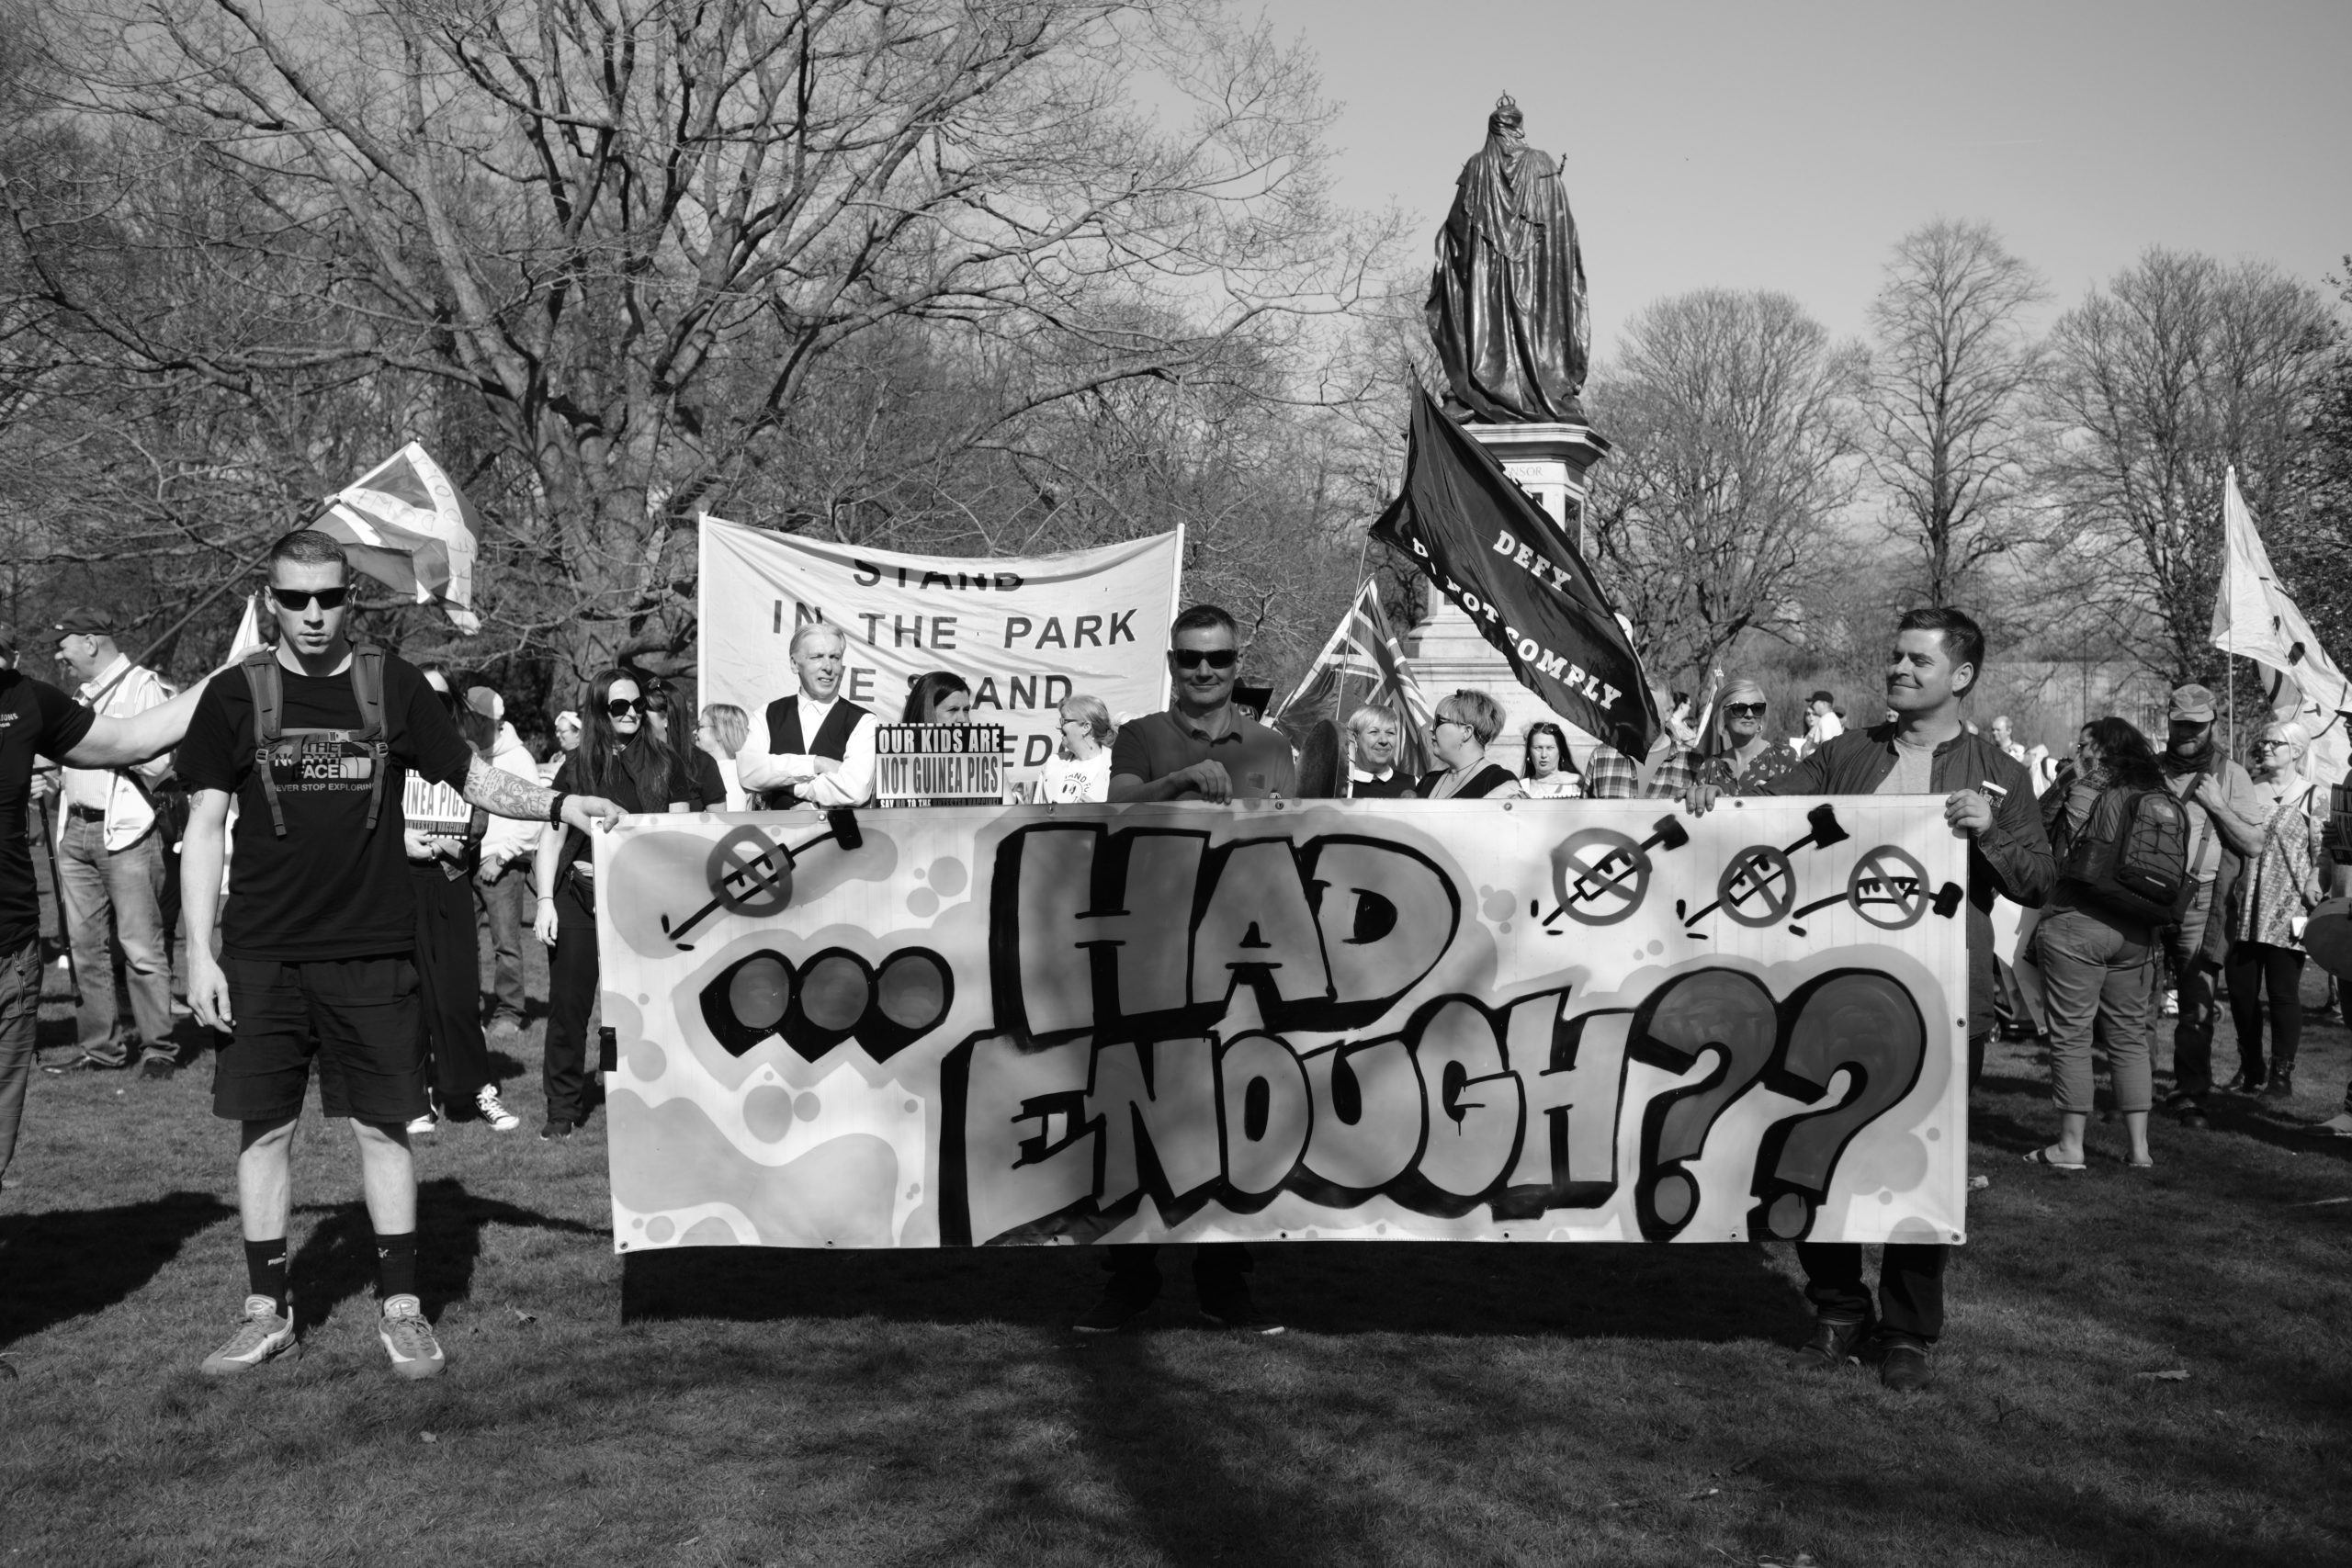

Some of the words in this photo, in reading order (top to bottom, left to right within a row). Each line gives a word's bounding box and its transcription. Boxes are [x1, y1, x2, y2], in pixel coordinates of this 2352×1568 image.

[1510, 466, 1544, 477] NSOR
[1493, 530, 1572, 592] DEFY
[858, 612, 957, 649] THE
[1004, 608, 1137, 649] PARK
[838, 665, 876, 703] E
[0, 713, 18, 721] IONS
[878, 729, 915, 753] OUR
[921, 728, 963, 752] KIDS
[968, 728, 1000, 752] ARE
[300, 764, 339, 778] ACE
[881, 757, 908, 795] NOT
[913, 756, 963, 795] GUINEA
[967, 756, 999, 794] PIGS
[276, 784, 299, 792] EVER
[301, 784, 326, 792] STOP
[328, 783, 373, 792] EXPLORIN
[405, 781, 435, 816] INEA
[880, 799, 894, 808] SAY
[991, 822, 1462, 1042] HAD
